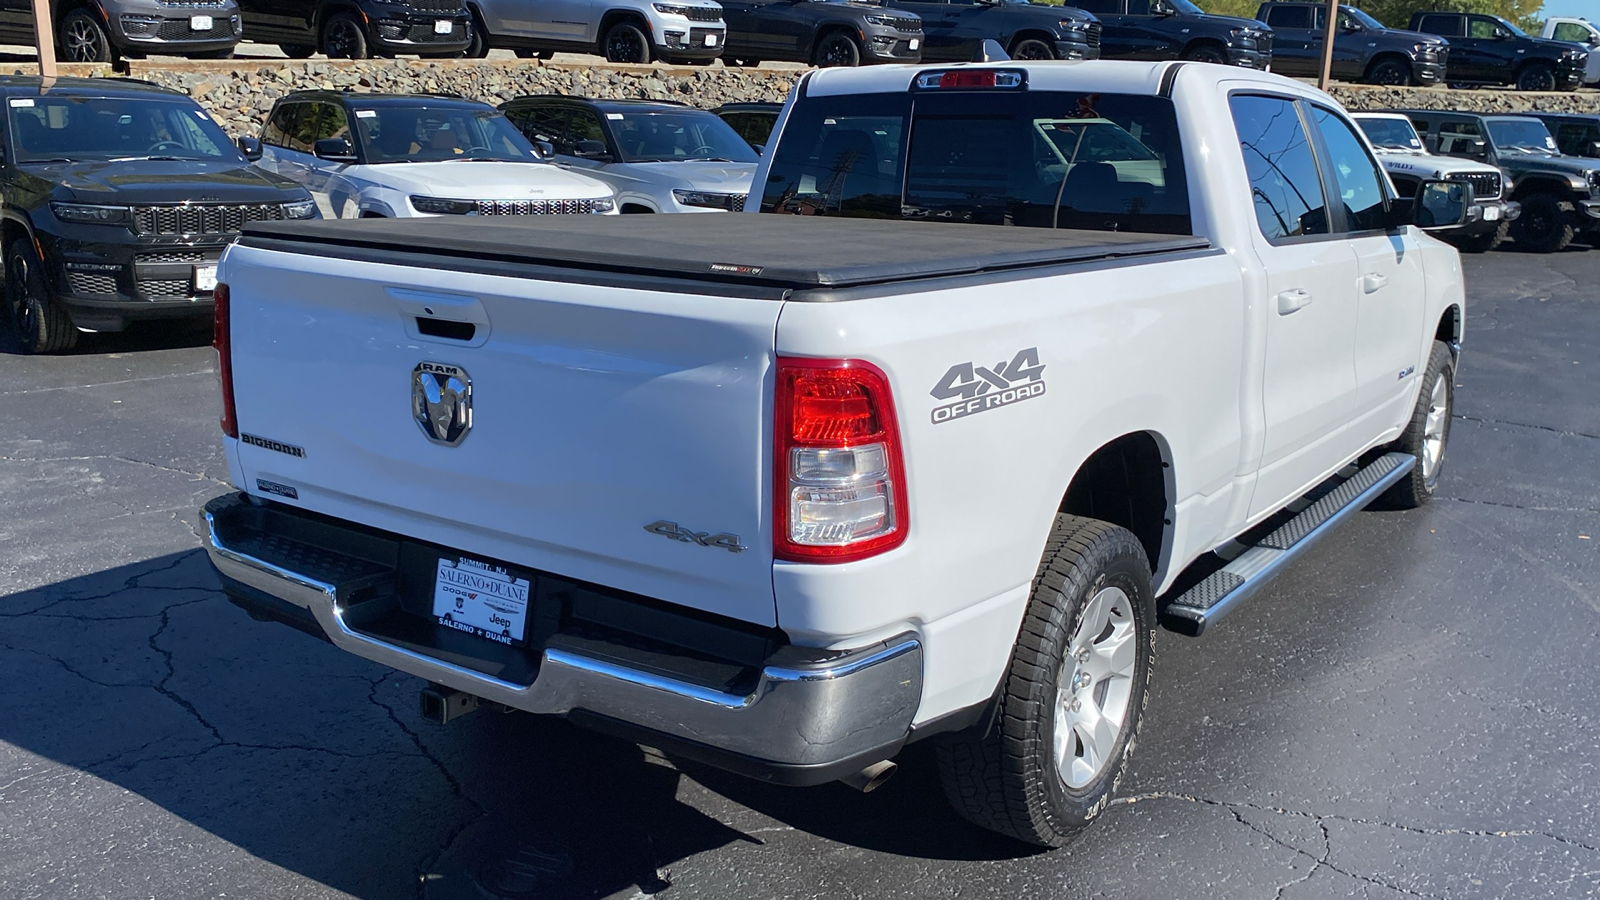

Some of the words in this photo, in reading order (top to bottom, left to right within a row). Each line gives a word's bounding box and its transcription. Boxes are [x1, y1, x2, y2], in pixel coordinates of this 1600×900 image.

[423, 364, 457, 375] RAM
[933, 399, 981, 422] OFF
[986, 383, 1044, 408] ROAD
[241, 432, 306, 458] BIGHORN
[440, 568, 485, 590] SALERNO
[490, 581, 526, 601] DUANE
[438, 617, 474, 633] SALERNO
[485, 631, 512, 645] DUANE
[489, 613, 511, 628] Jeep
